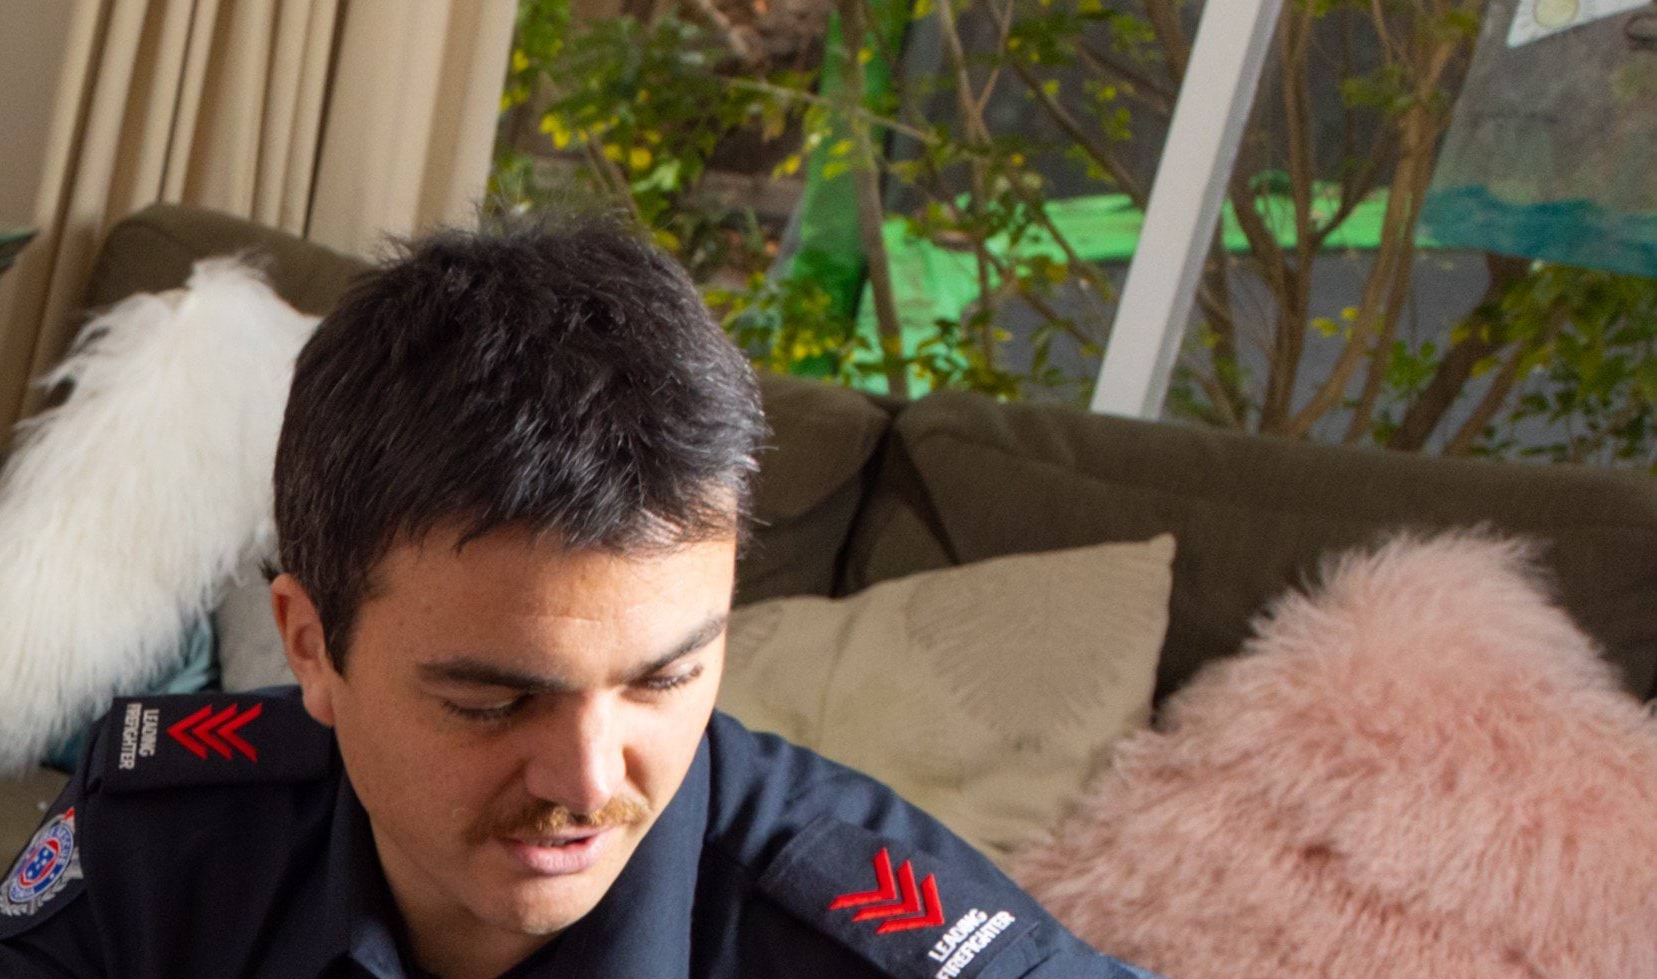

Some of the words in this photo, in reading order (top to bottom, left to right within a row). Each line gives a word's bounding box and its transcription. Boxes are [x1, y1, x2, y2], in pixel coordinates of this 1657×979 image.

[119, 703, 142, 770] FIREFIGHTER
[139, 708, 159, 756] LEADING
[928, 908, 988, 963] LEADING
